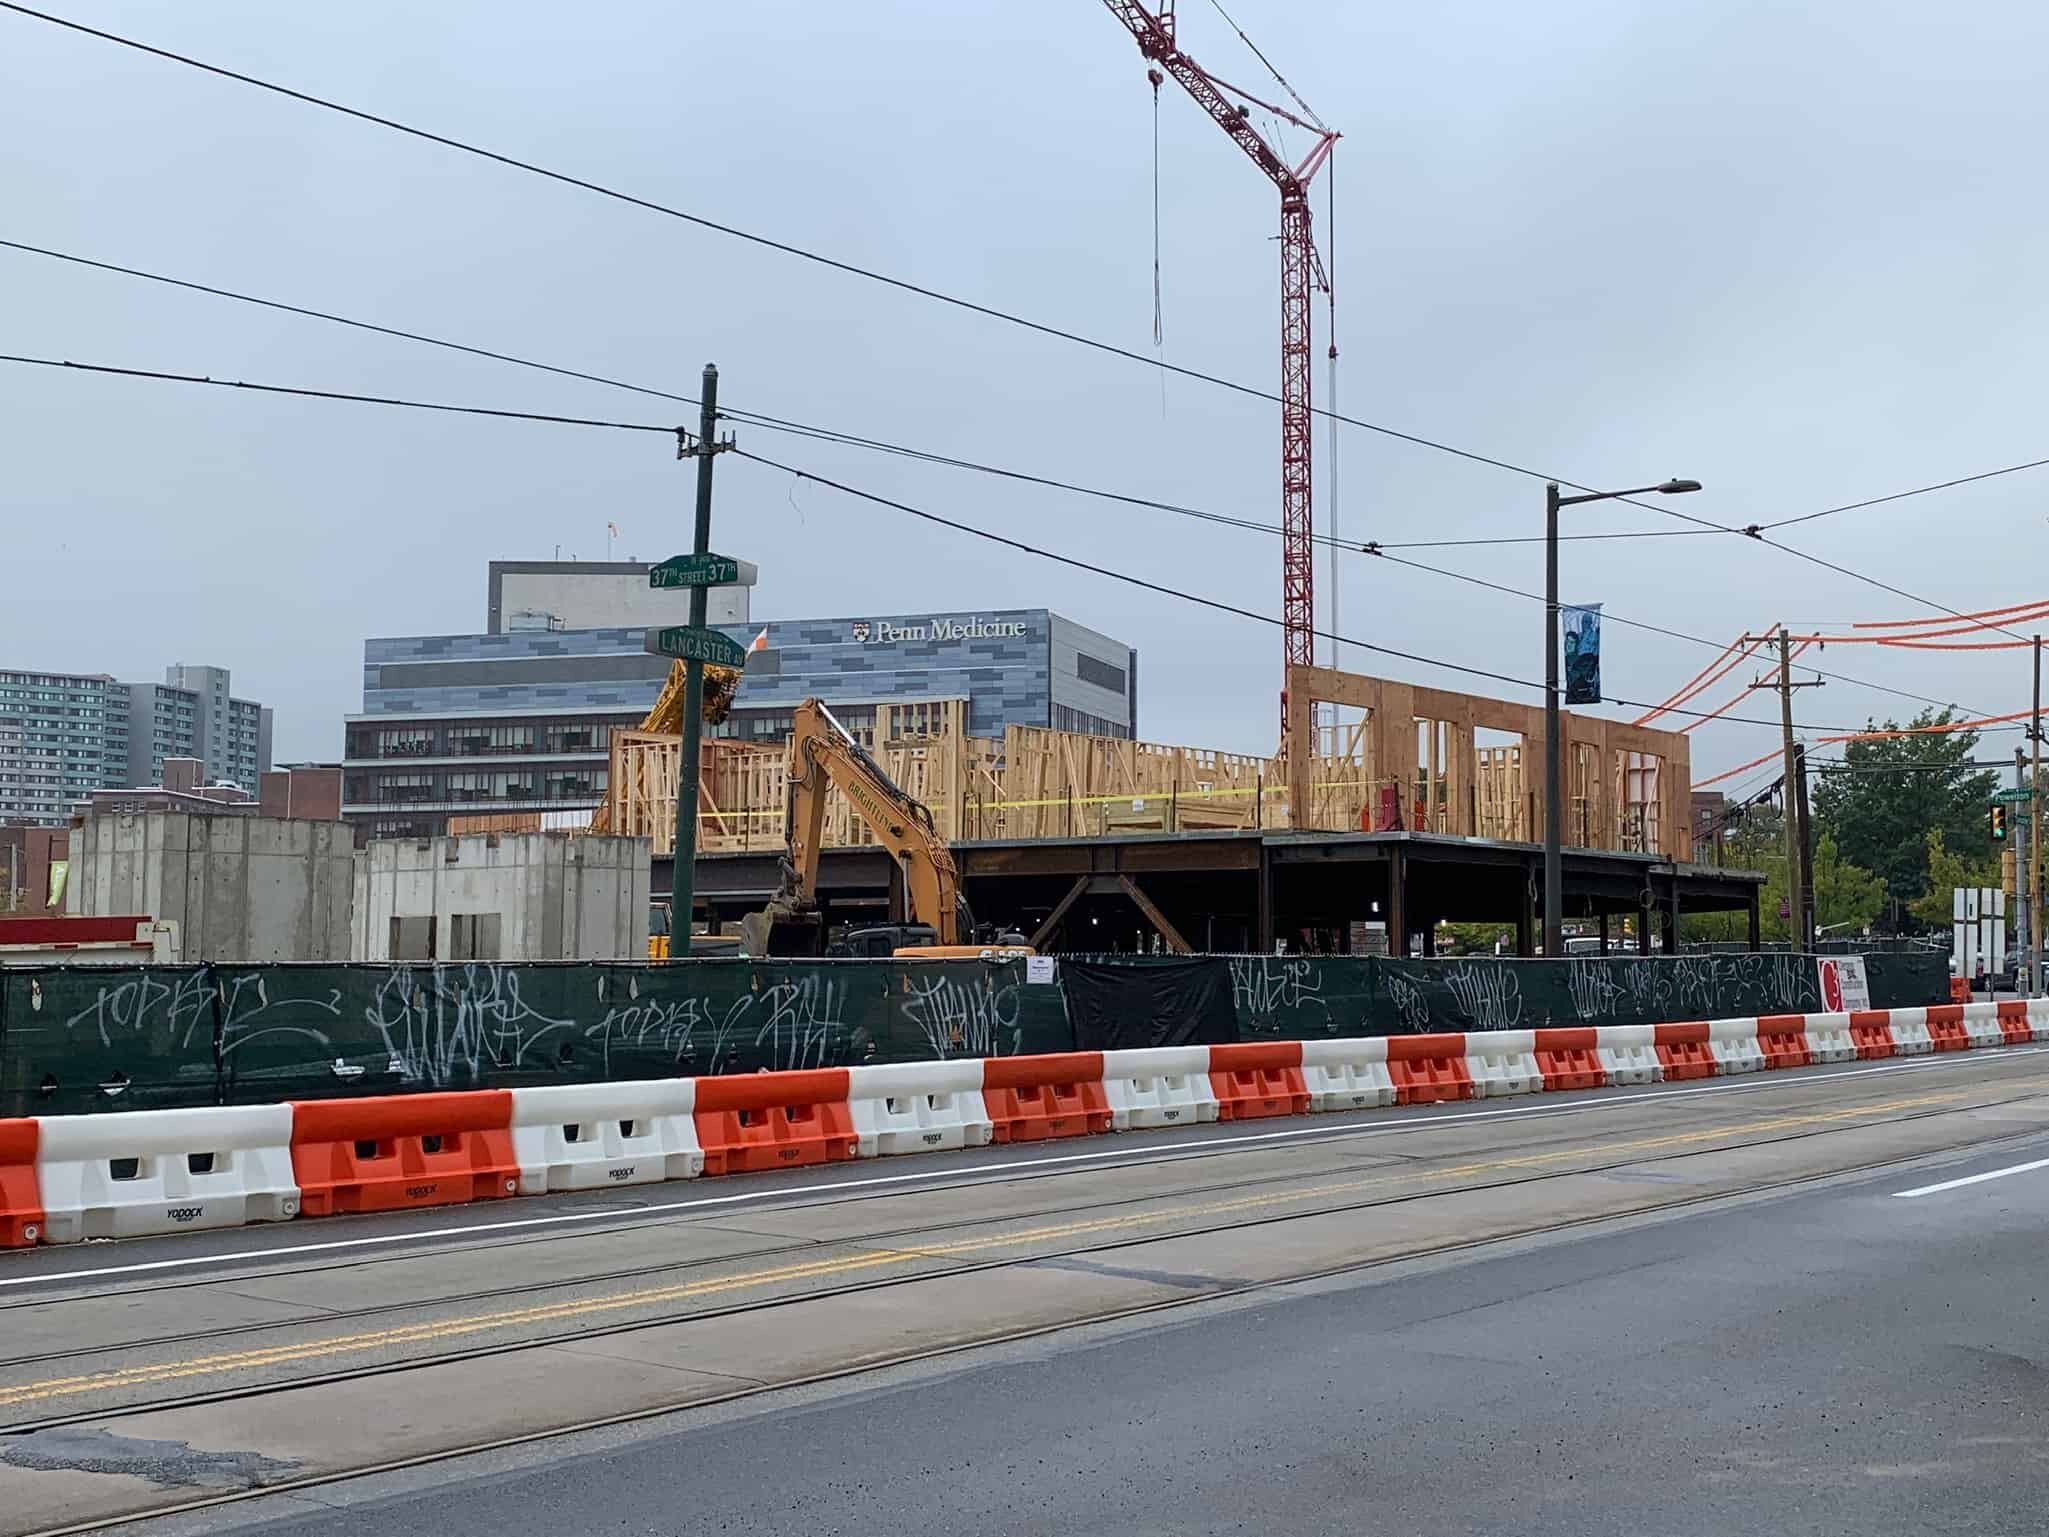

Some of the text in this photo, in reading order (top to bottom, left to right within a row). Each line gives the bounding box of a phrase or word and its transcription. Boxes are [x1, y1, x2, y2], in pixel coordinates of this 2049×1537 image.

[679, 569, 706, 585] STREET
[708, 562, 736, 581] 37TH
[876, 616, 1026, 642] Penn Medicine
[662, 631, 732, 665] LANCASTER
[848, 781, 896, 834] BRIGHTLIN
[167, 1206, 203, 1218] YODOCK
